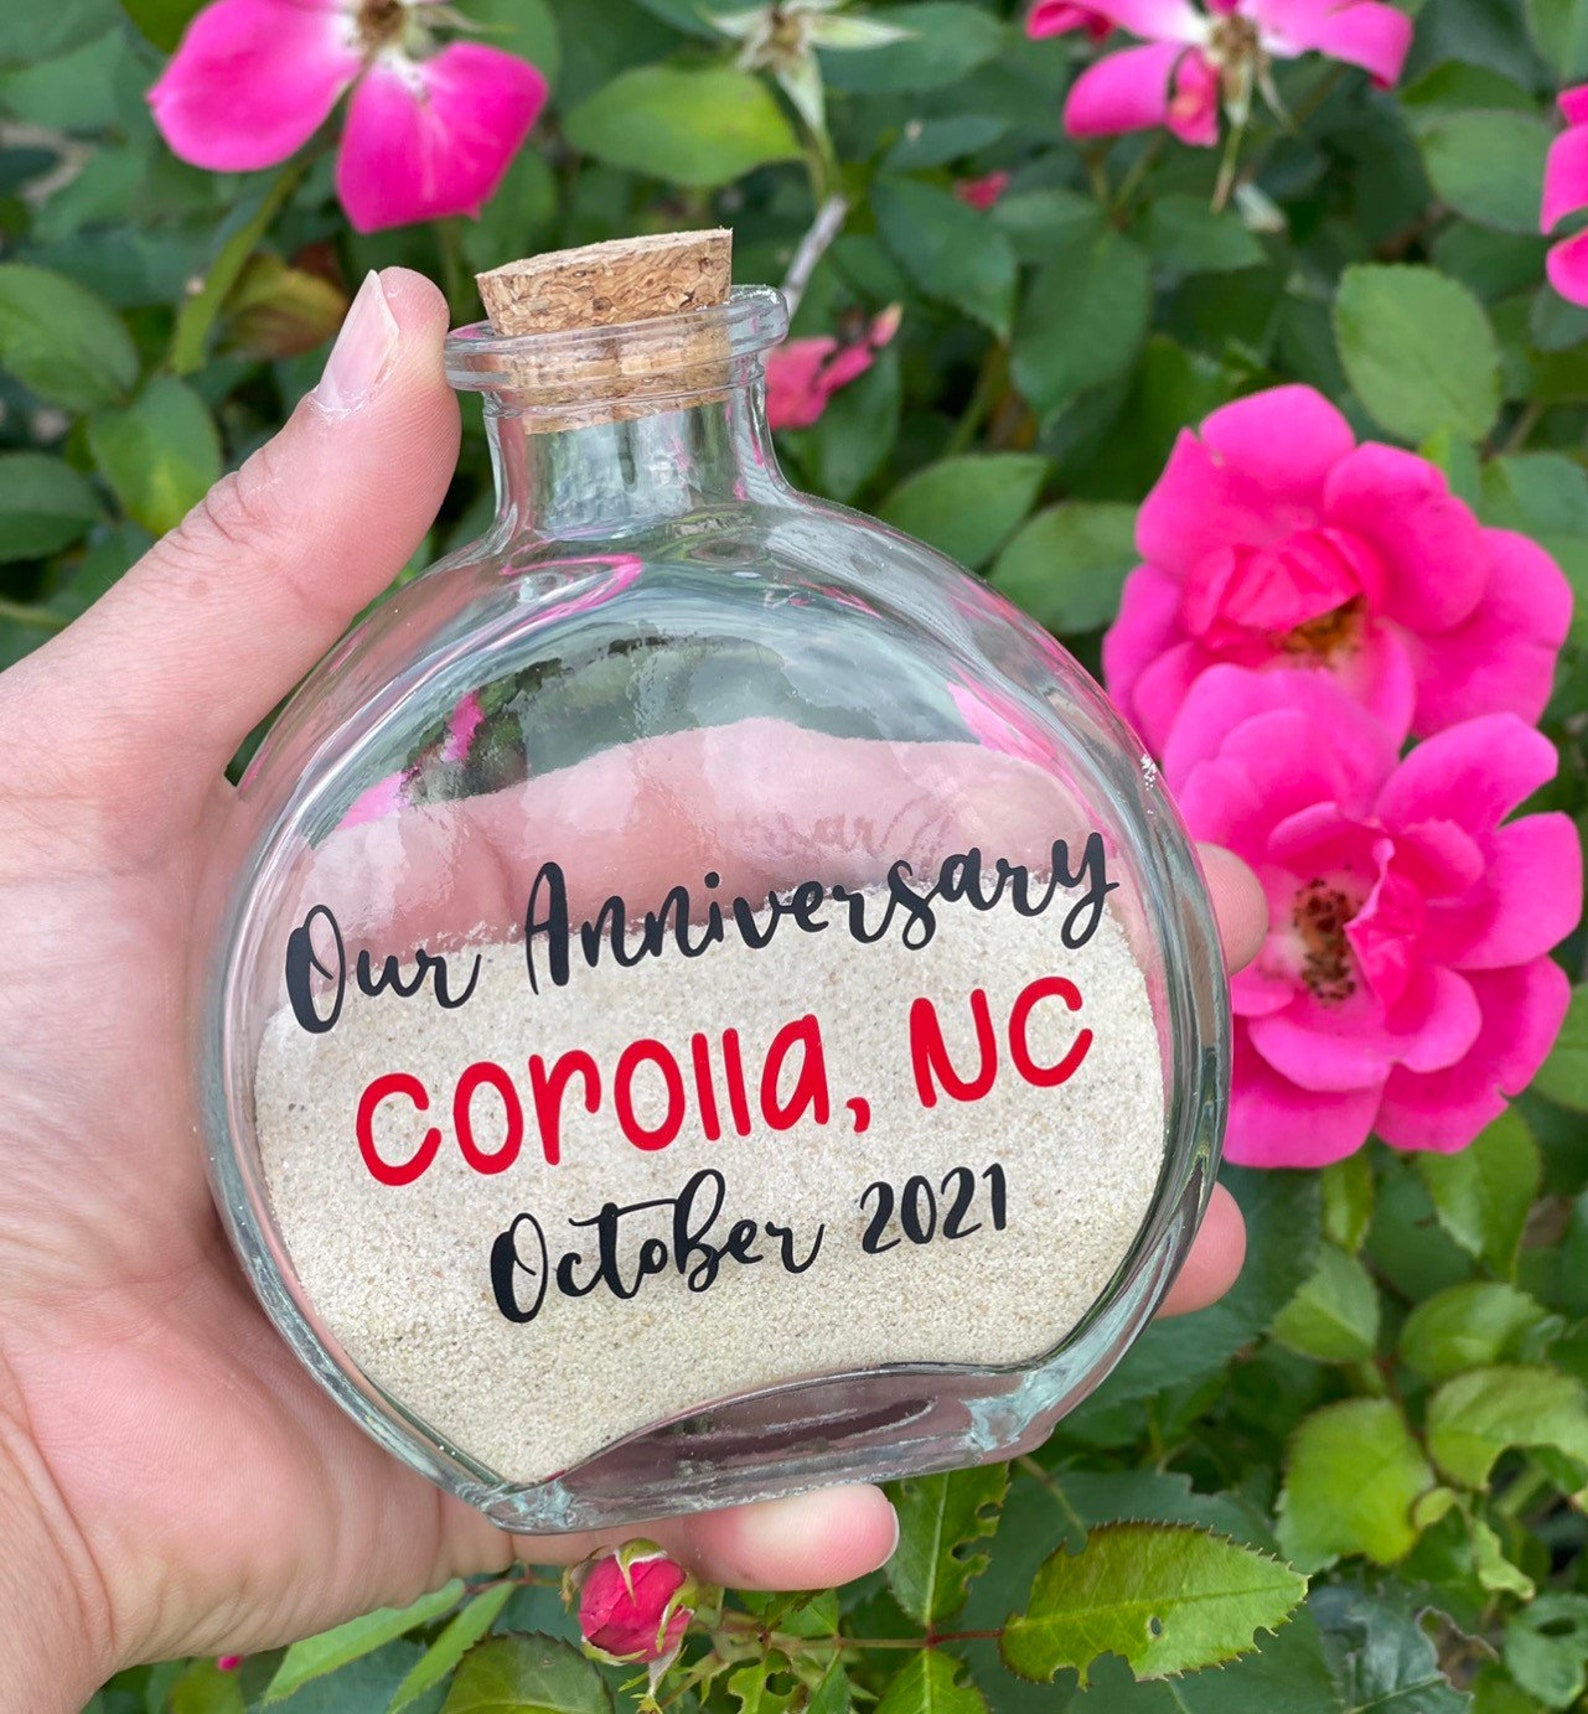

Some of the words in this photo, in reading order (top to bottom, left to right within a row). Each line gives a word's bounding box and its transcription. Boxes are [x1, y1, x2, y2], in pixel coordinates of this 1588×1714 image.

[285, 903, 482, 1034] Our
[524, 832, 1120, 995] Anniversary
[909, 976, 1094, 1108] NC
[490, 1169, 825, 1324] October
[859, 1163, 1008, 1255] 2021
